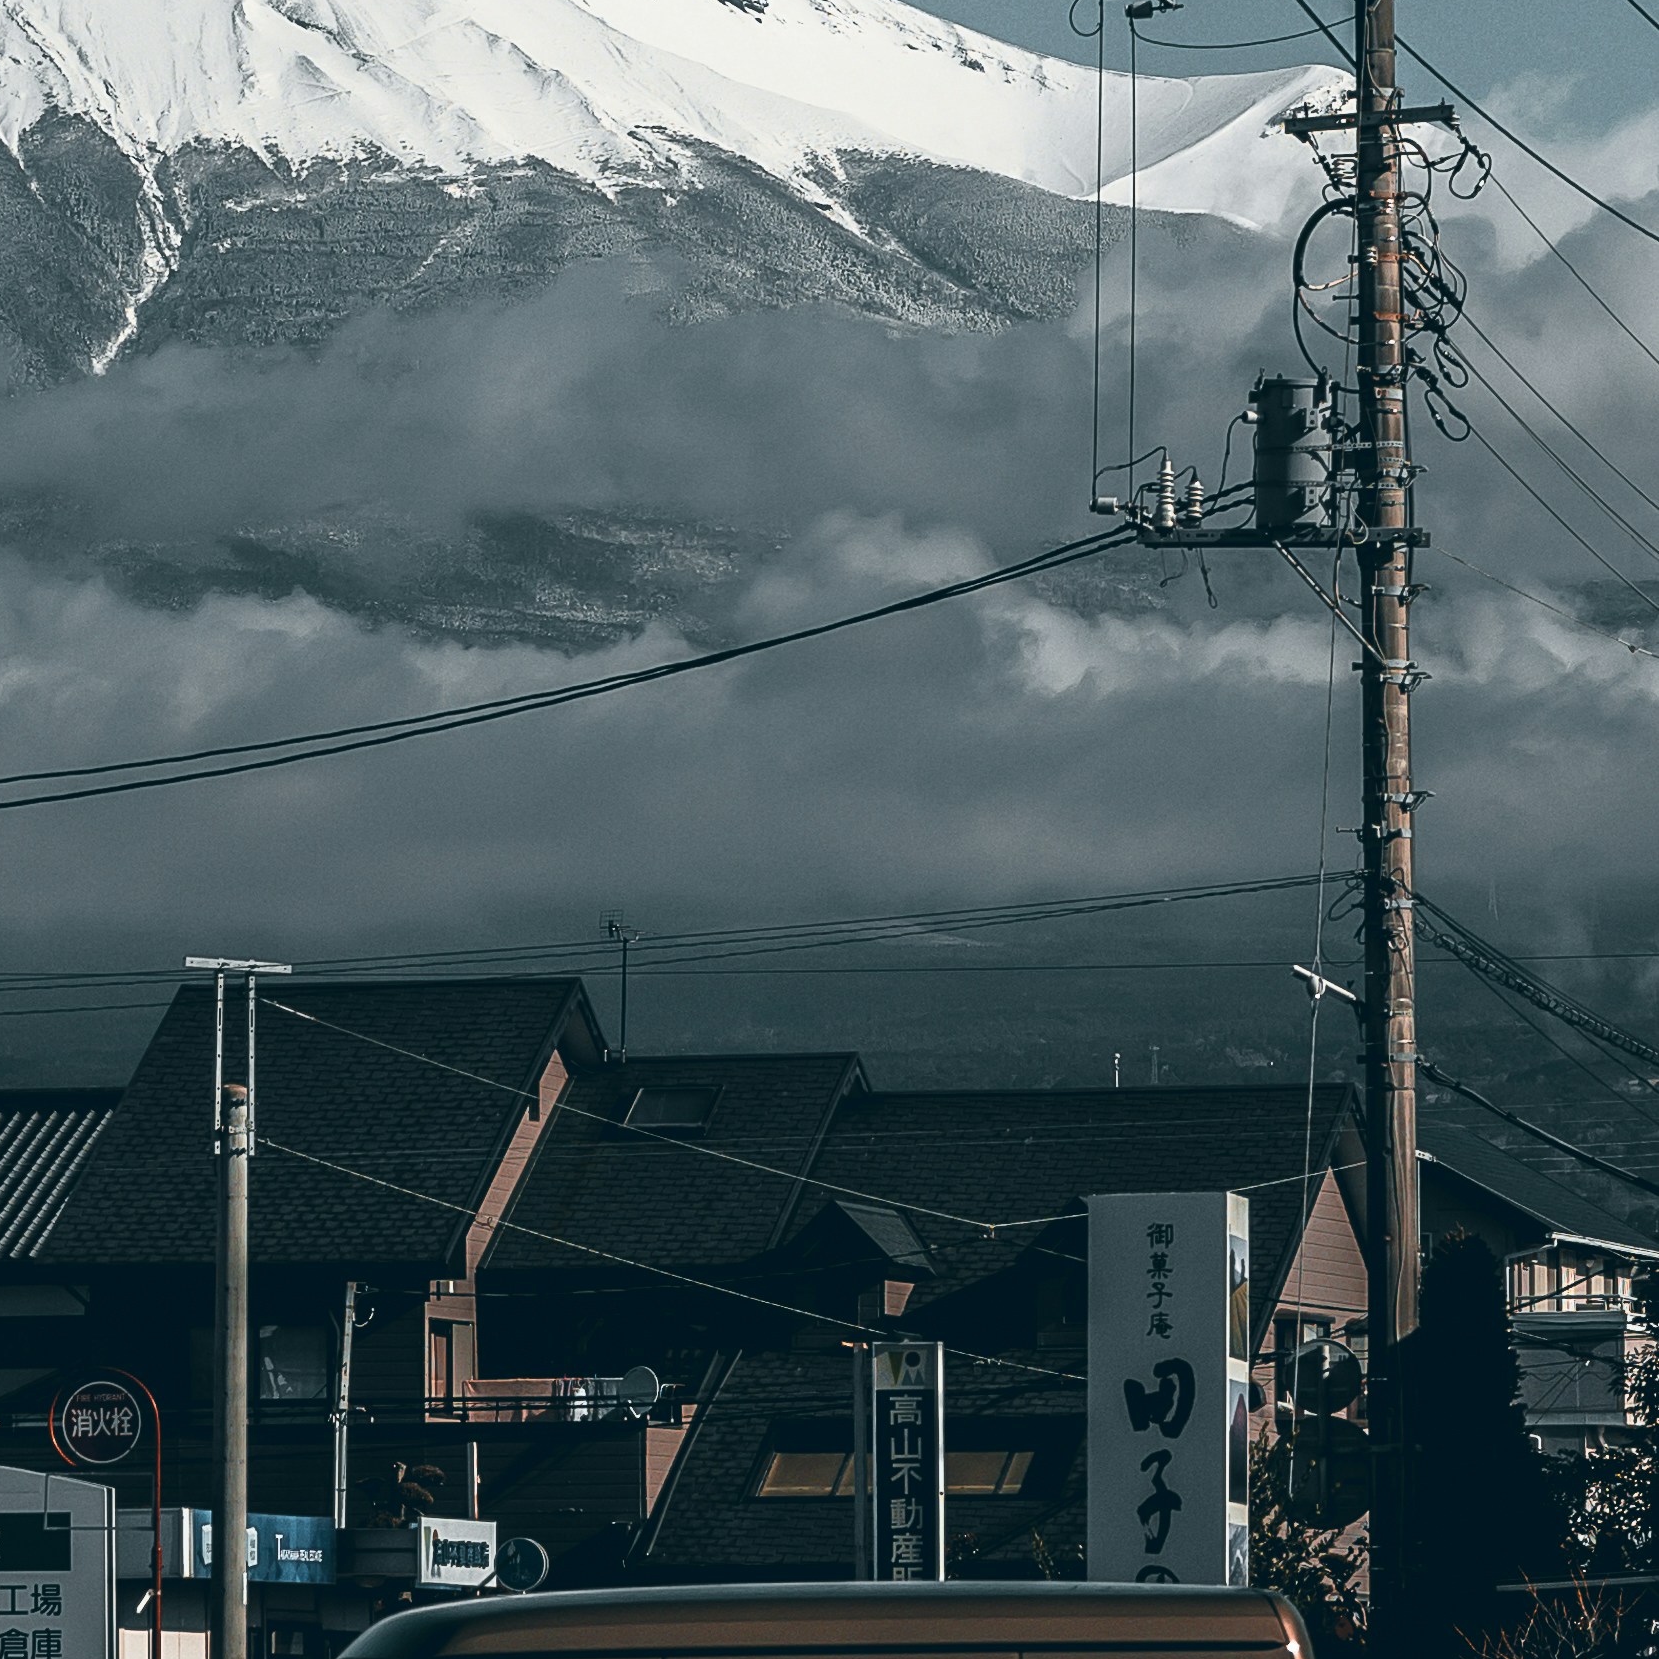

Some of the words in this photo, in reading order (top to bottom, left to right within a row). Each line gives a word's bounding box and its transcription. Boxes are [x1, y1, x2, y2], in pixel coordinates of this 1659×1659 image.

[1145, 1222, 1174, 1340] 御菓子庵
[71, 1407, 133, 1437] 消火栓
